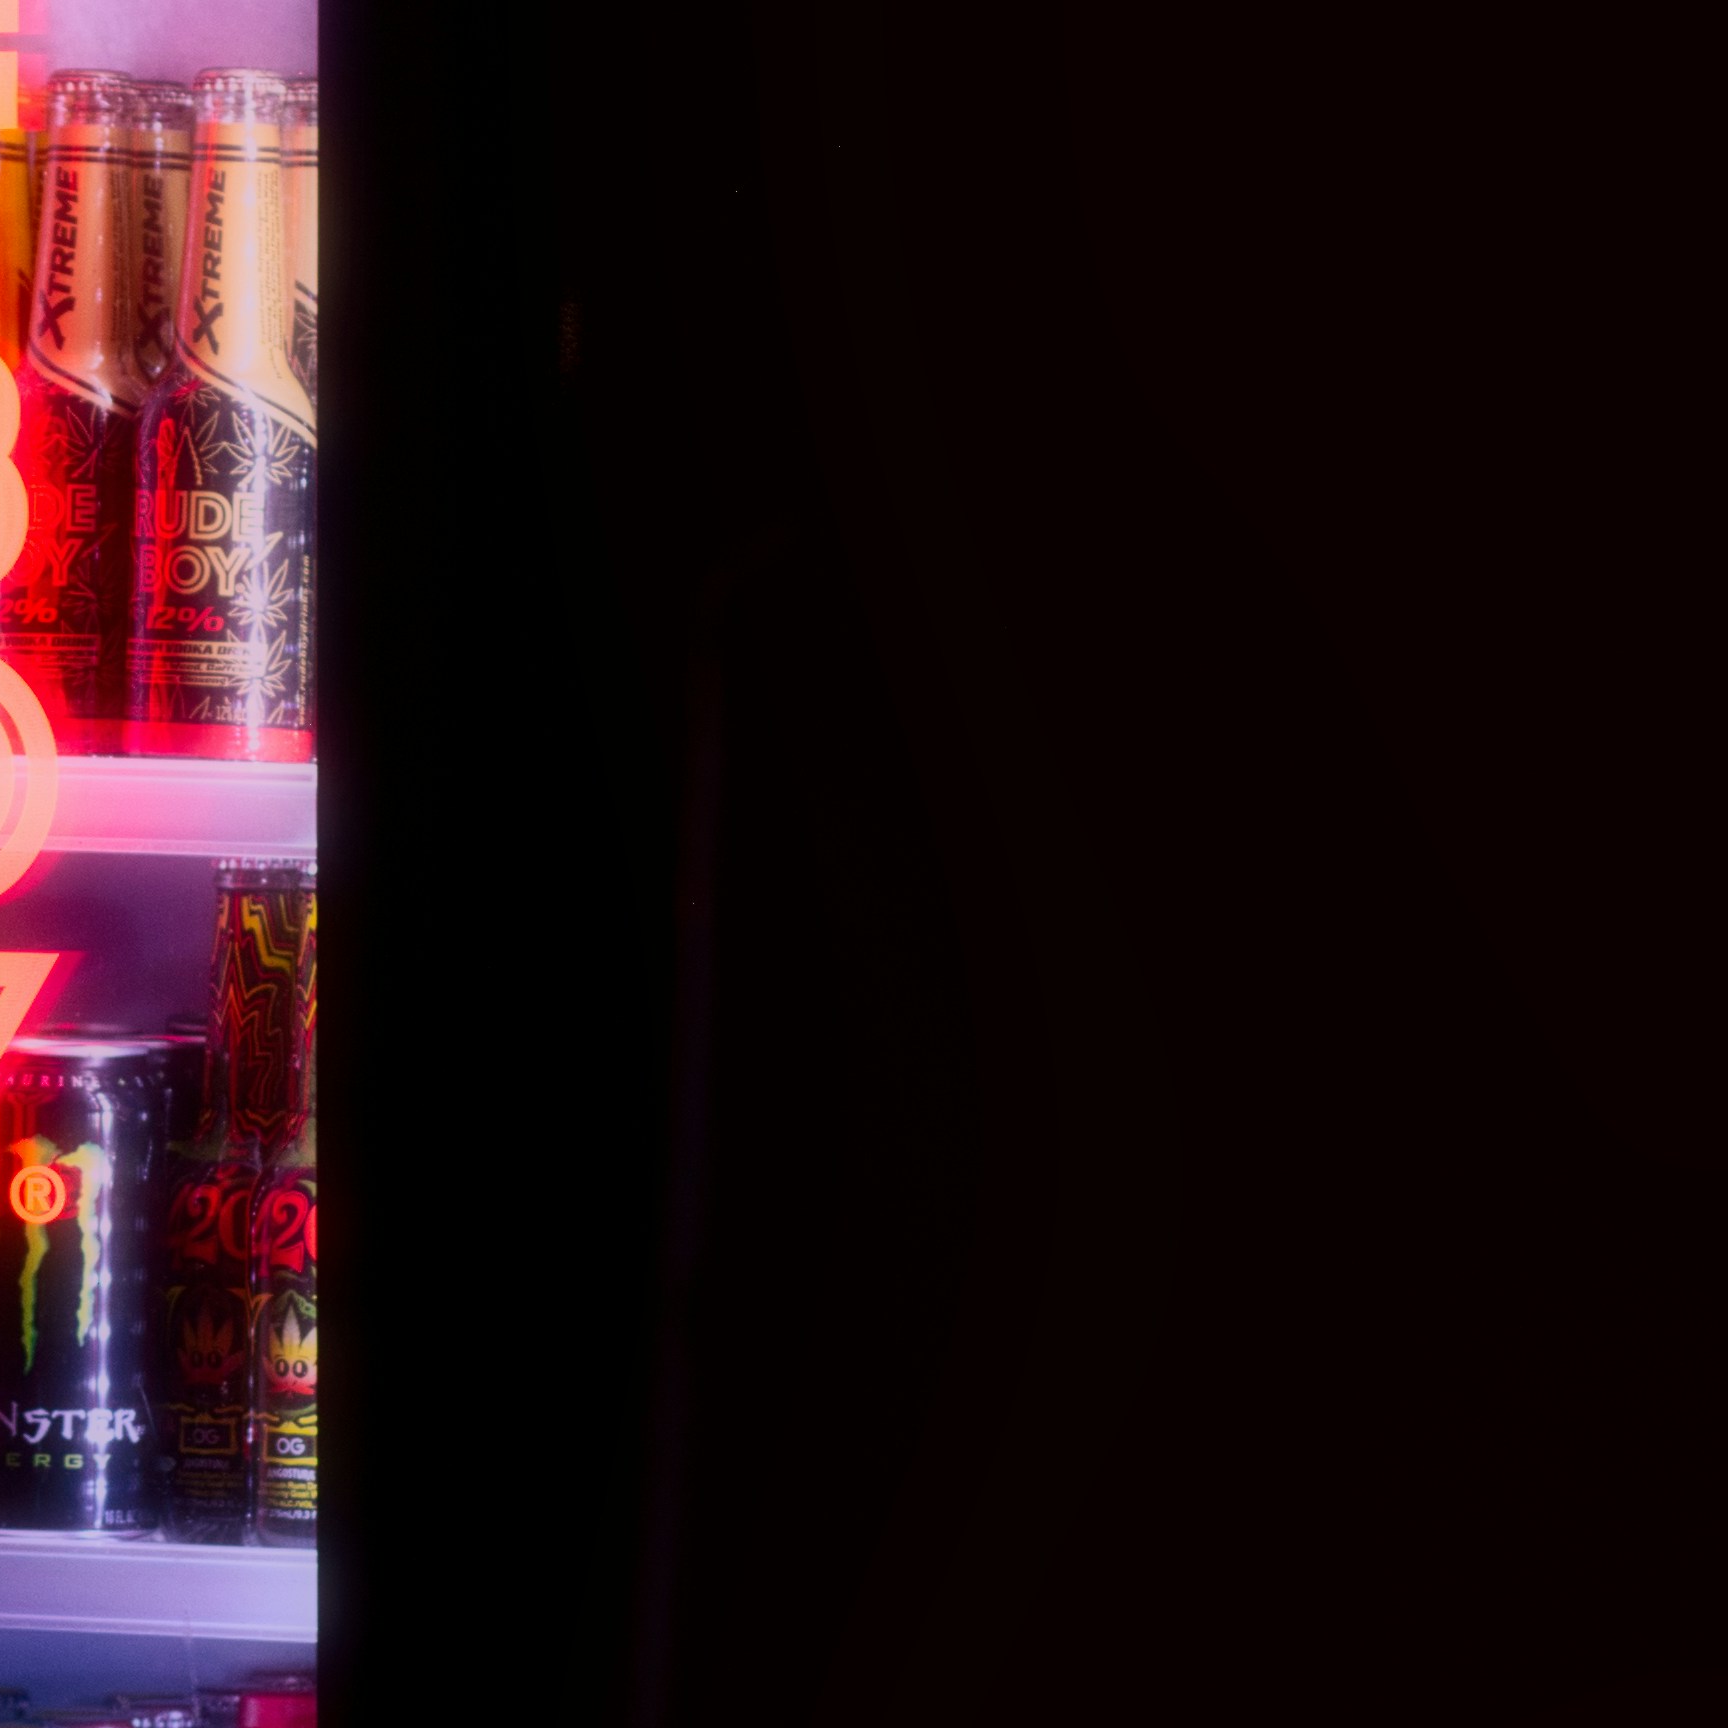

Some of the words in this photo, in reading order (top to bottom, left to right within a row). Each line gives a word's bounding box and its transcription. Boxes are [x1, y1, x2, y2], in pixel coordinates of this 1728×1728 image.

[38, 165, 79, 352] XTREME
[192, 166, 226, 357] XTREME
[135, 490, 266, 541] RUDE
[145, 606, 225, 633] 12%
[276, 1436, 307, 1457] OG
